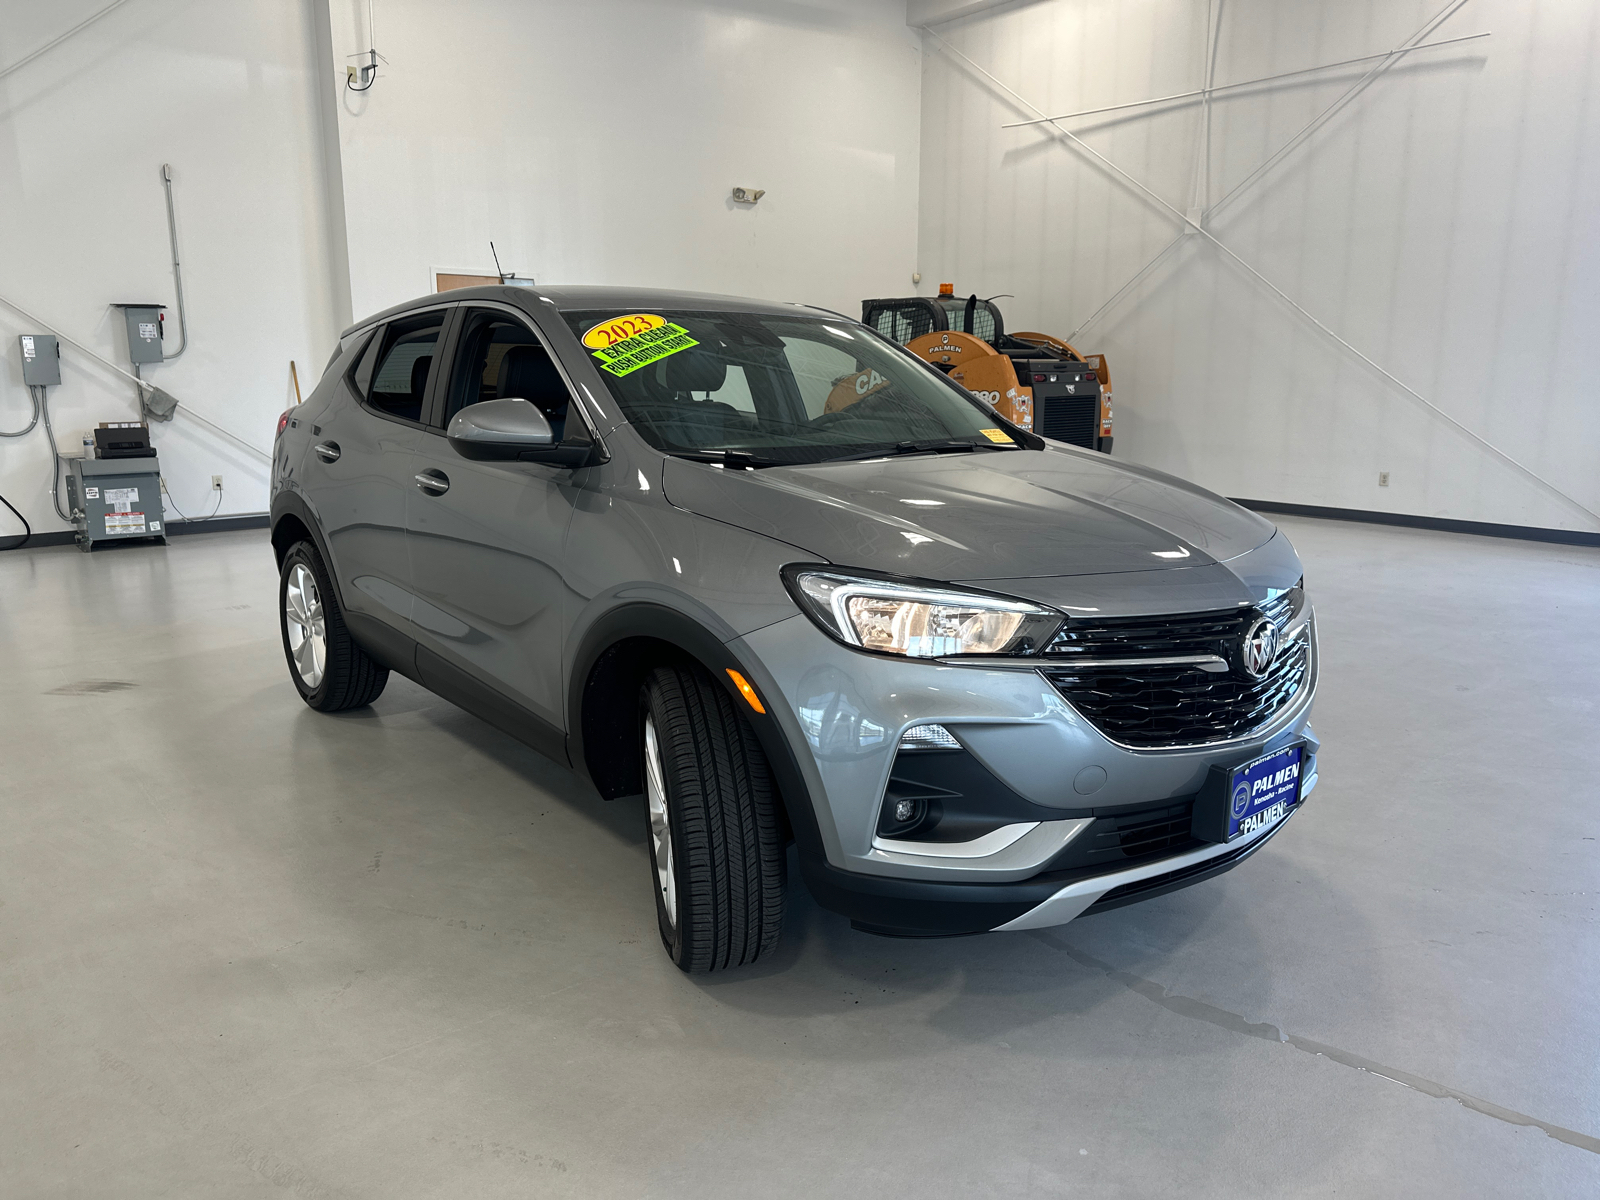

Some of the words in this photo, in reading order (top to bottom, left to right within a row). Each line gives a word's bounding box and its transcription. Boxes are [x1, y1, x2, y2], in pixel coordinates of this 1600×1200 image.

[598, 316, 653, 345] 2023
[601, 337, 643, 360] EXTRA
[639, 325, 680, 343] CLEAN
[606, 355, 636, 374] PUSH
[630, 343, 665, 363] BUTTON
[662, 335, 694, 350] START
[929, 345, 962, 354] PALMEN
[1249, 747, 1290, 769] palmen.com
[1252, 762, 1300, 797] PALMEN
[1254, 791, 1275, 806] Kenosha
[1278, 783, 1294, 795] Racine
[1244, 801, 1284, 834] PALMEN
